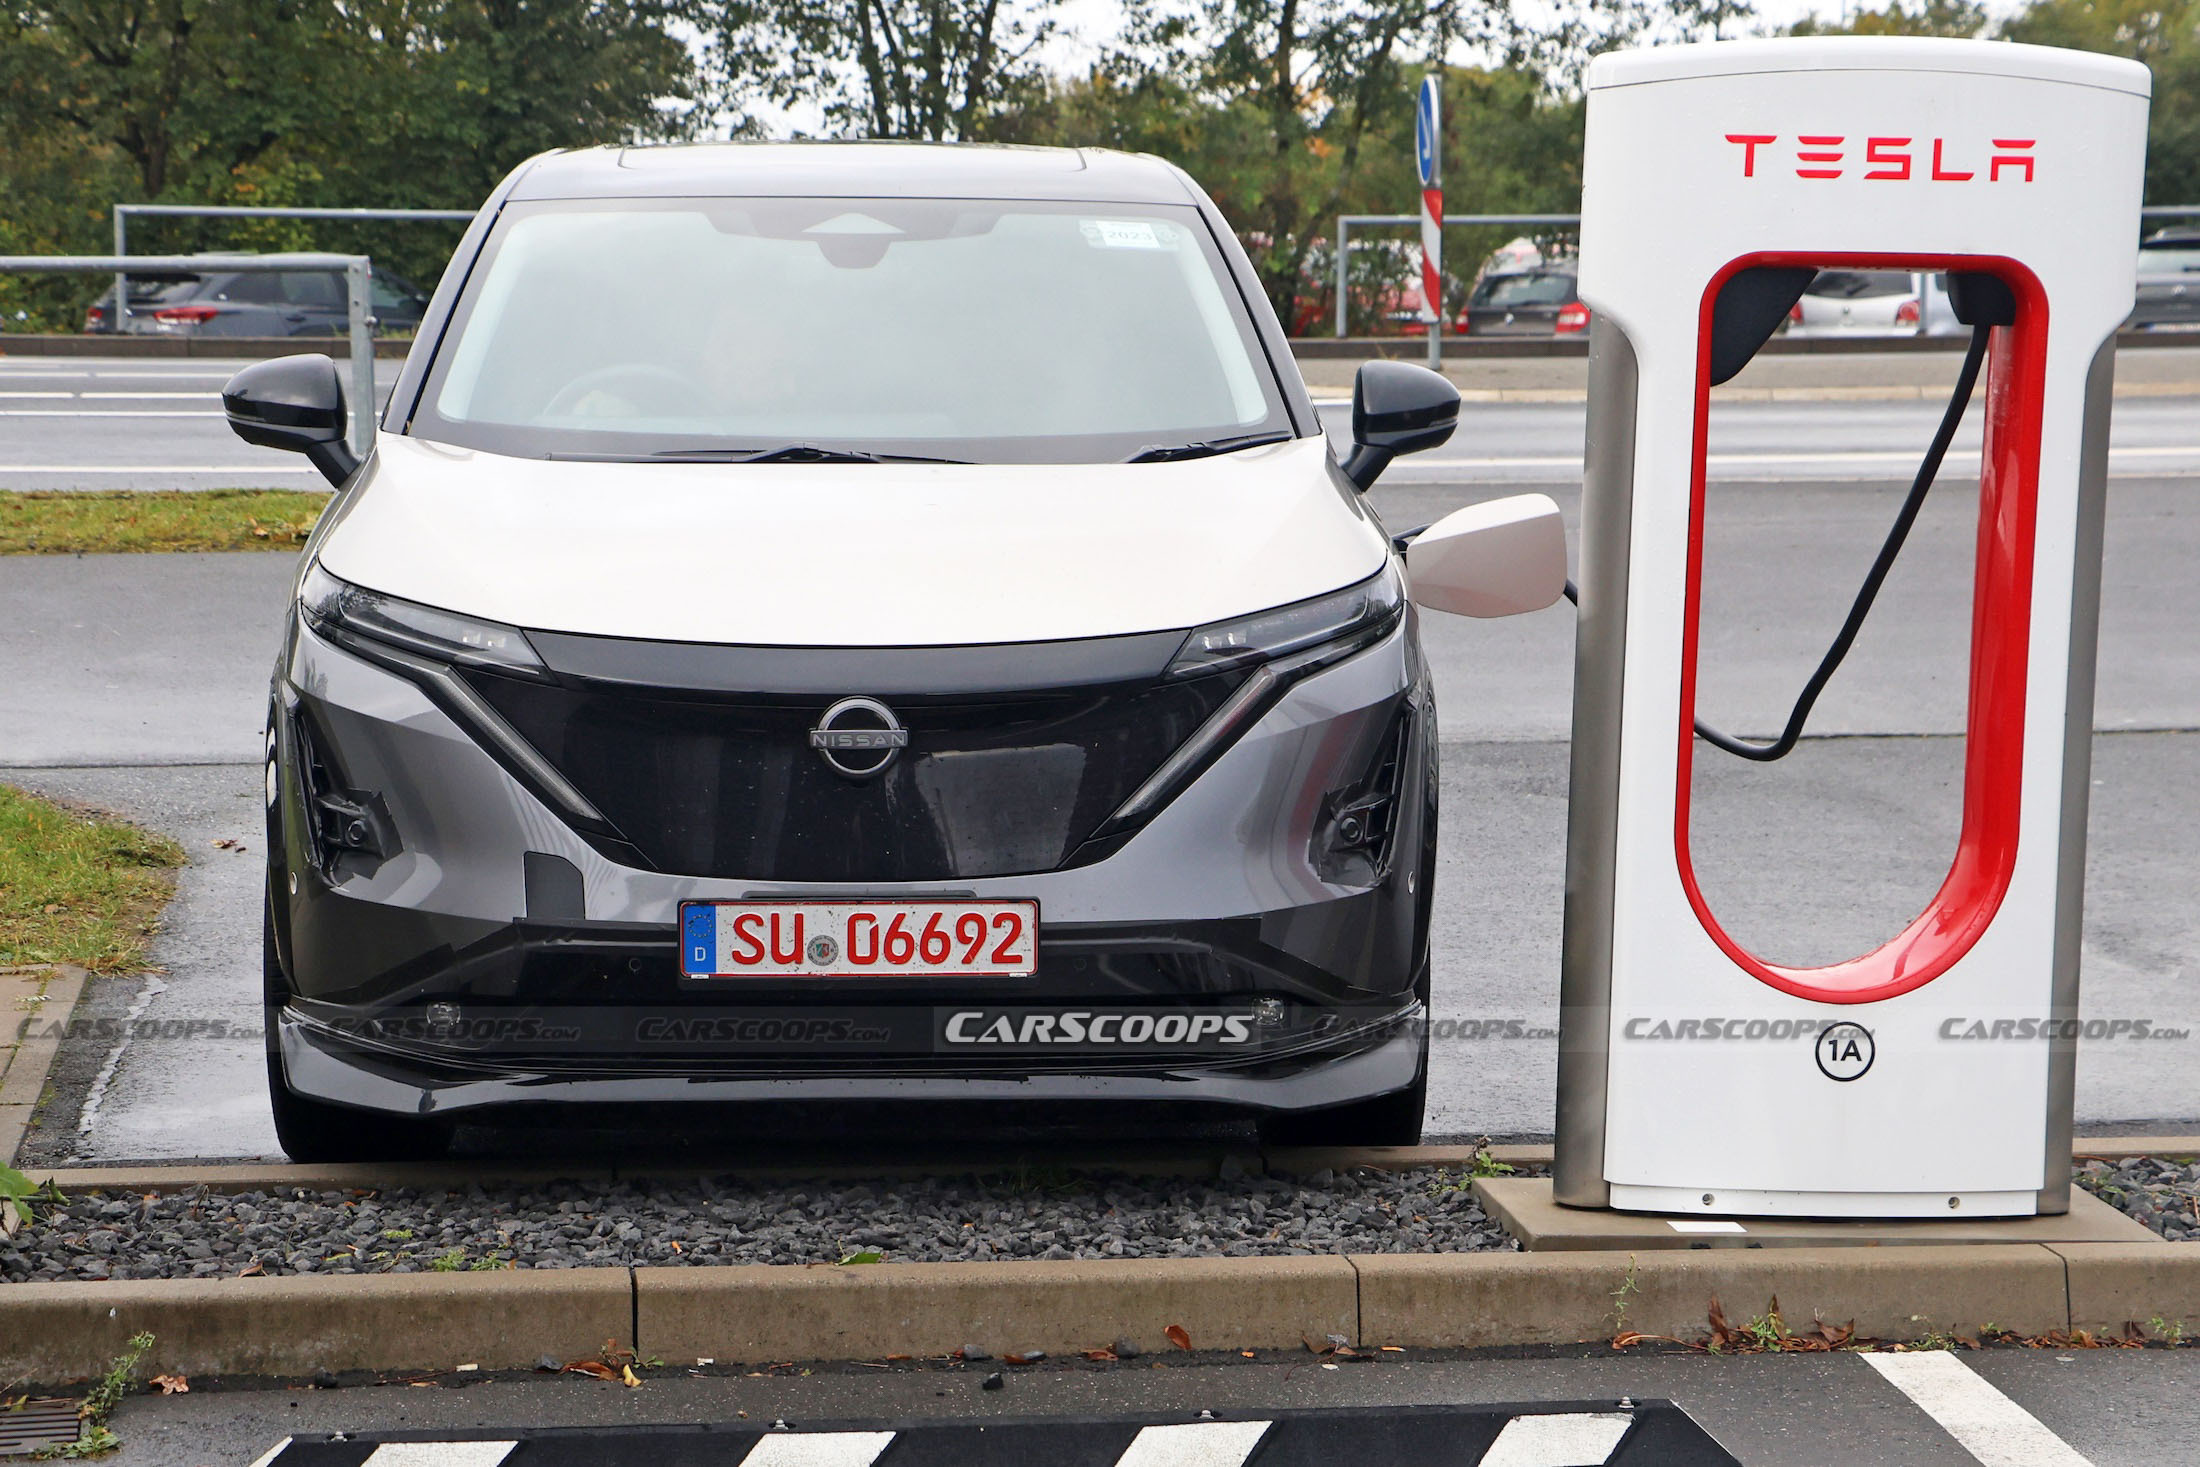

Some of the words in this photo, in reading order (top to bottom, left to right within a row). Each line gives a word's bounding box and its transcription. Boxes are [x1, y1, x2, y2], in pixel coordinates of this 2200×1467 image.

[1724, 134, 2037, 183] TESLA
[812, 734, 907, 747] NISSAN
[731, 912, 805, 965] SU
[847, 912, 1023, 965] 06692
[694, 946, 706, 962] D
[1828, 1039, 1862, 1062] 1A
